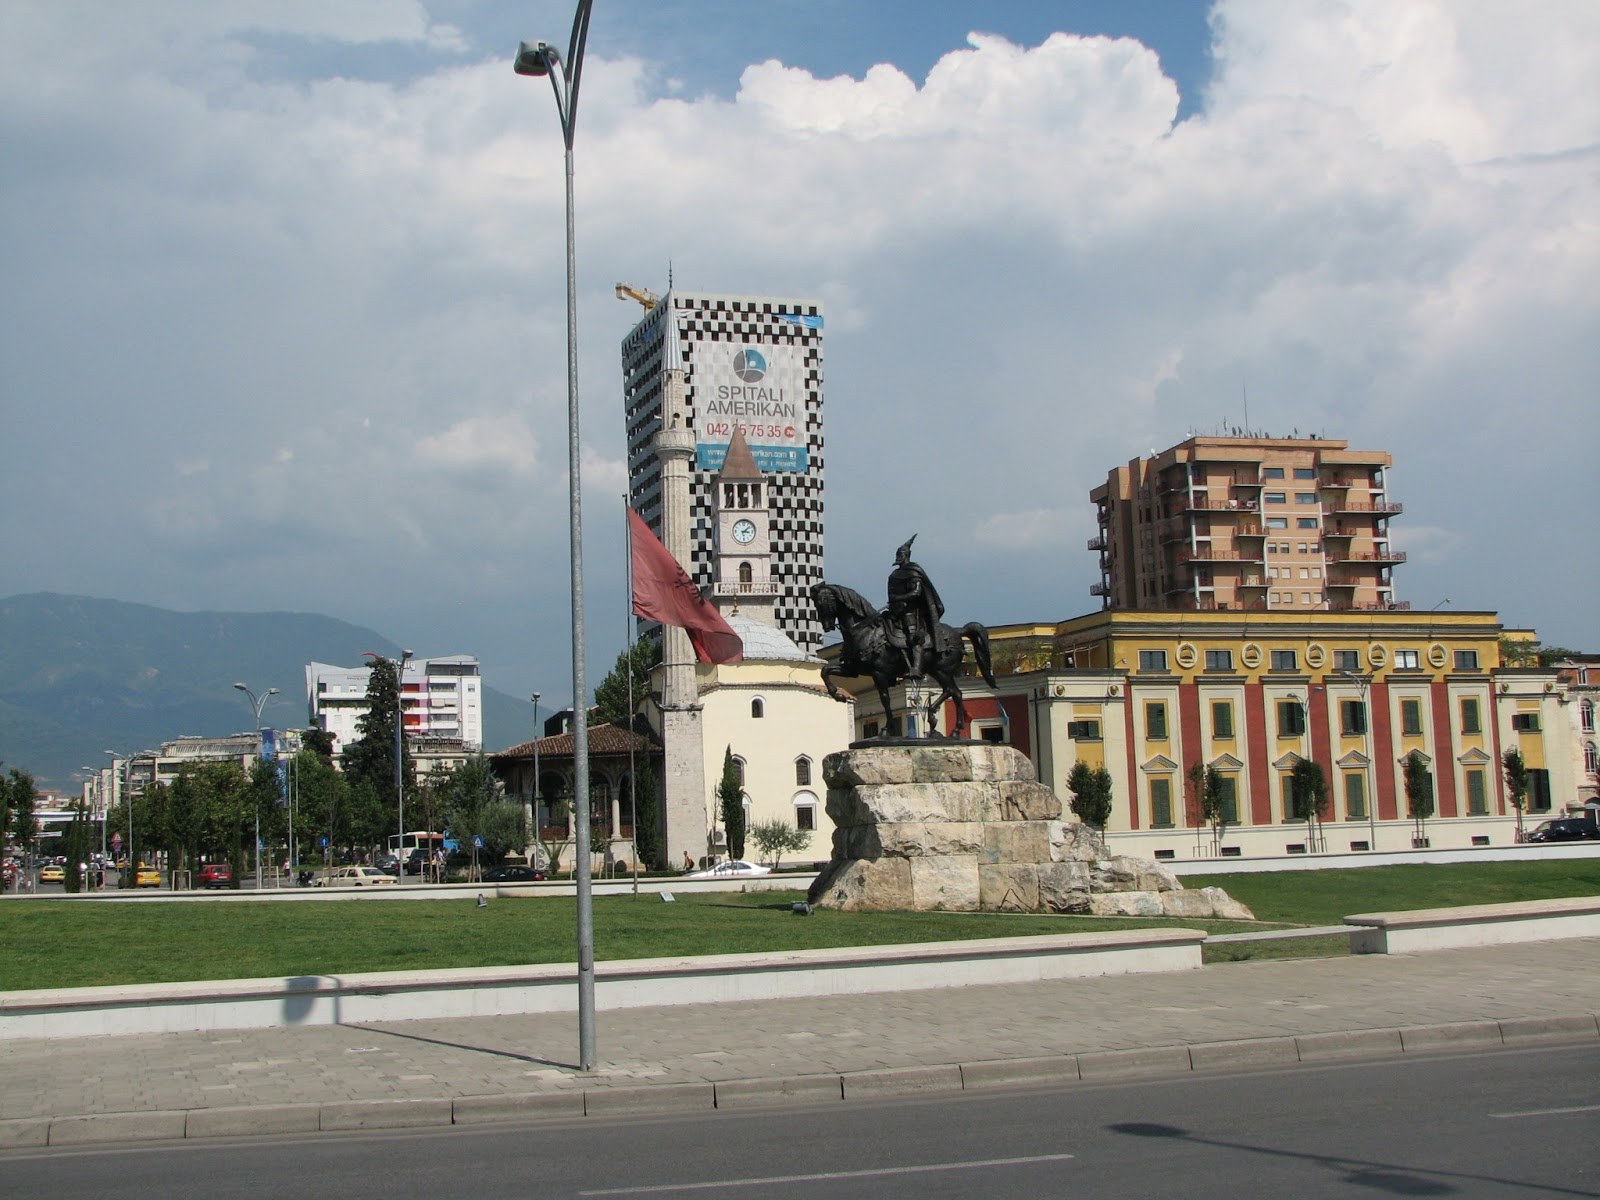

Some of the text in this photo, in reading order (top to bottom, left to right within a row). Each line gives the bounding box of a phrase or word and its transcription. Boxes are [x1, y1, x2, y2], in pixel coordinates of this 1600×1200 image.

[718, 385, 783, 402] SPITALI
[706, 400, 795, 418] AMERIKAN
[706, 423, 729, 436] 042
[750, 424, 764, 438] 75
[767, 425, 781, 438] 35
